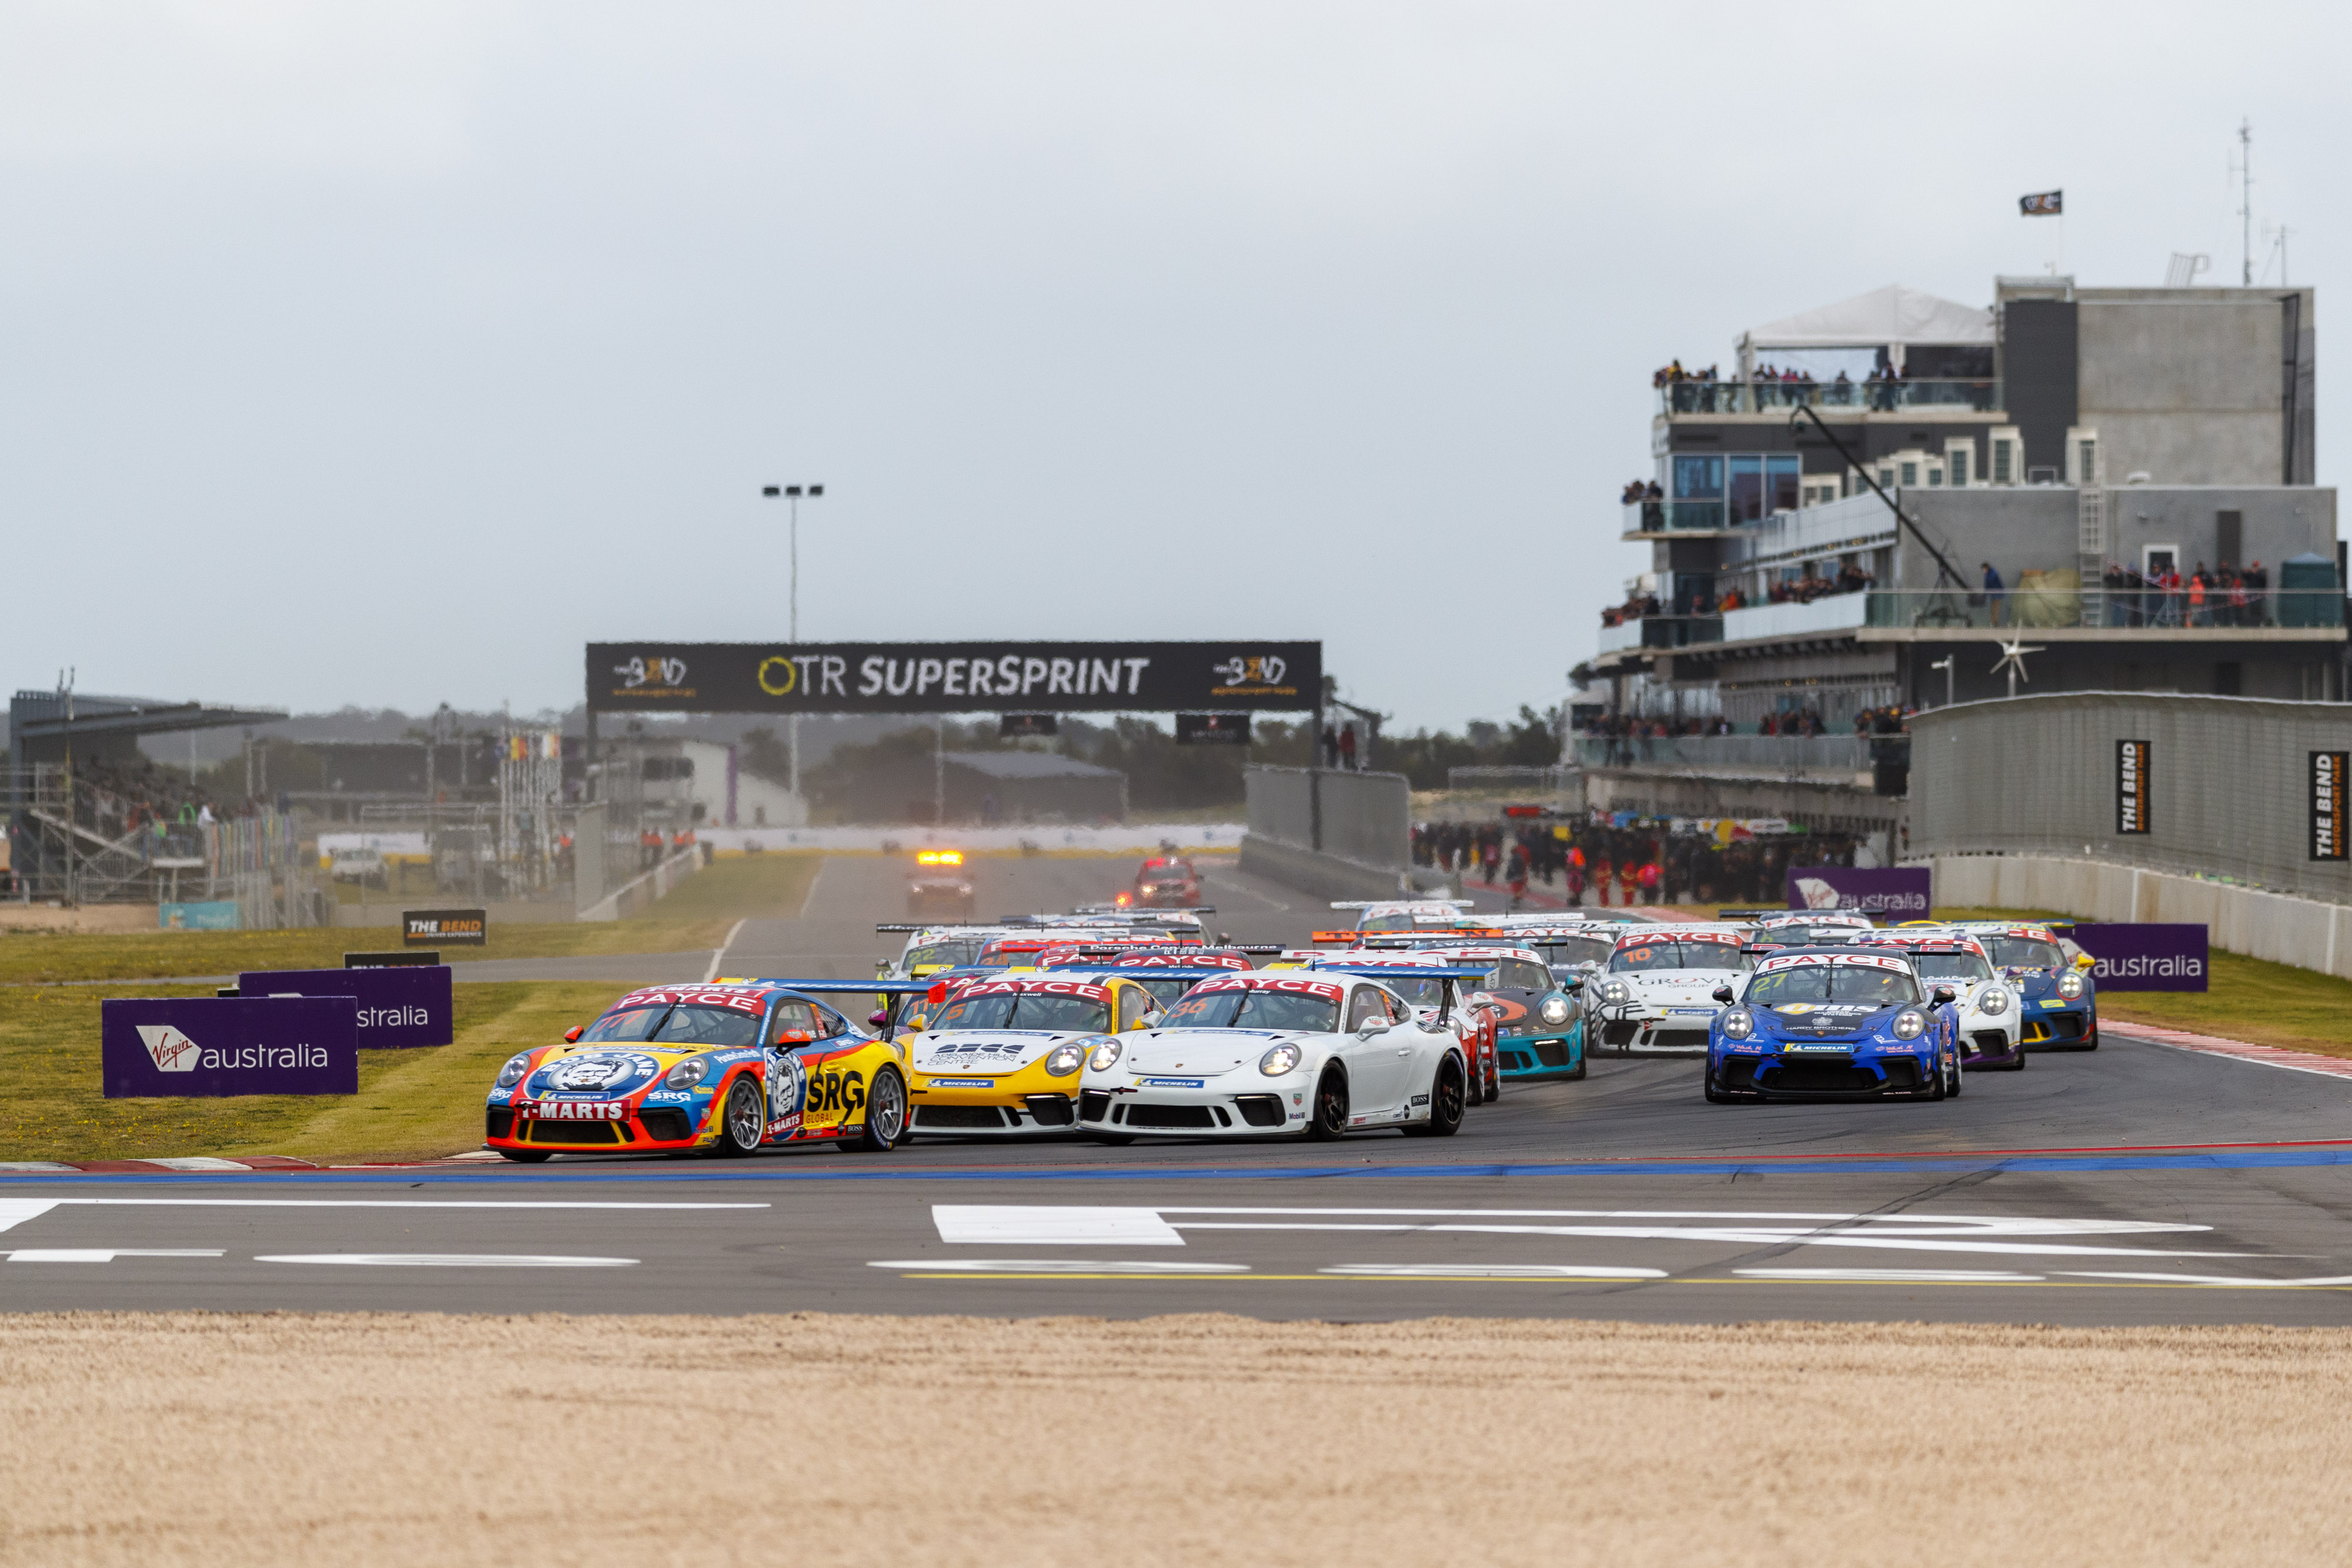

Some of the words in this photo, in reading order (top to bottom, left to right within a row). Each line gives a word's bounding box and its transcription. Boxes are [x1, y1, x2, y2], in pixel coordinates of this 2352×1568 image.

[758, 655, 846, 696] OTR
[858, 654, 1150, 696] SUPERSPRINT
[2122, 741, 2137, 794] BEND
[2332, 755, 2341, 784] PARK
[2316, 754, 2333, 813] BEND
[2122, 797, 2137, 831] THE
[2316, 816, 2333, 857] THE
[1839, 891, 1927, 910] australia
[409, 920, 439, 933] THE
[441, 920, 482, 932] BEND
[1766, 917, 1864, 928] PAYCE
[1625, 932, 1738, 947] PAYCE
[1864, 938, 1974, 951] AYCE
[908, 948, 936, 965] 22
[1119, 955, 1244, 972] PAYCE
[1623, 947, 1651, 964] 10
[1768, 955, 1900, 970] PAYCE
[2093, 954, 2202, 978] australia
[962, 981, 1104, 999] PAYCE
[1195, 979, 1337, 996] PAYCE
[1638, 978, 1733, 986] GROVE
[1753, 972, 1788, 994] 27
[617, 992, 758, 1011] PAYCE
[1170, 998, 1208, 1019] 36
[356, 1005, 429, 1028] stralia
[595, 1009, 646, 1033] 777
[945, 1003, 967, 1021] 5
[152, 1032, 193, 1068] Virgin
[202, 1043, 328, 1069] australia
[539, 1053, 604, 1072] BOB
[613, 1052, 656, 1076] JANE
[489, 1088, 513, 1099] SRG
[647, 1092, 691, 1102] SRG
[806, 1071, 866, 1113] SRG
[1412, 1095, 1427, 1104] BOSS
[520, 1102, 623, 1119] T-MARTS
[806, 1112, 833, 1124] GLOBAL
[767, 1114, 800, 1135] T-MARTS
